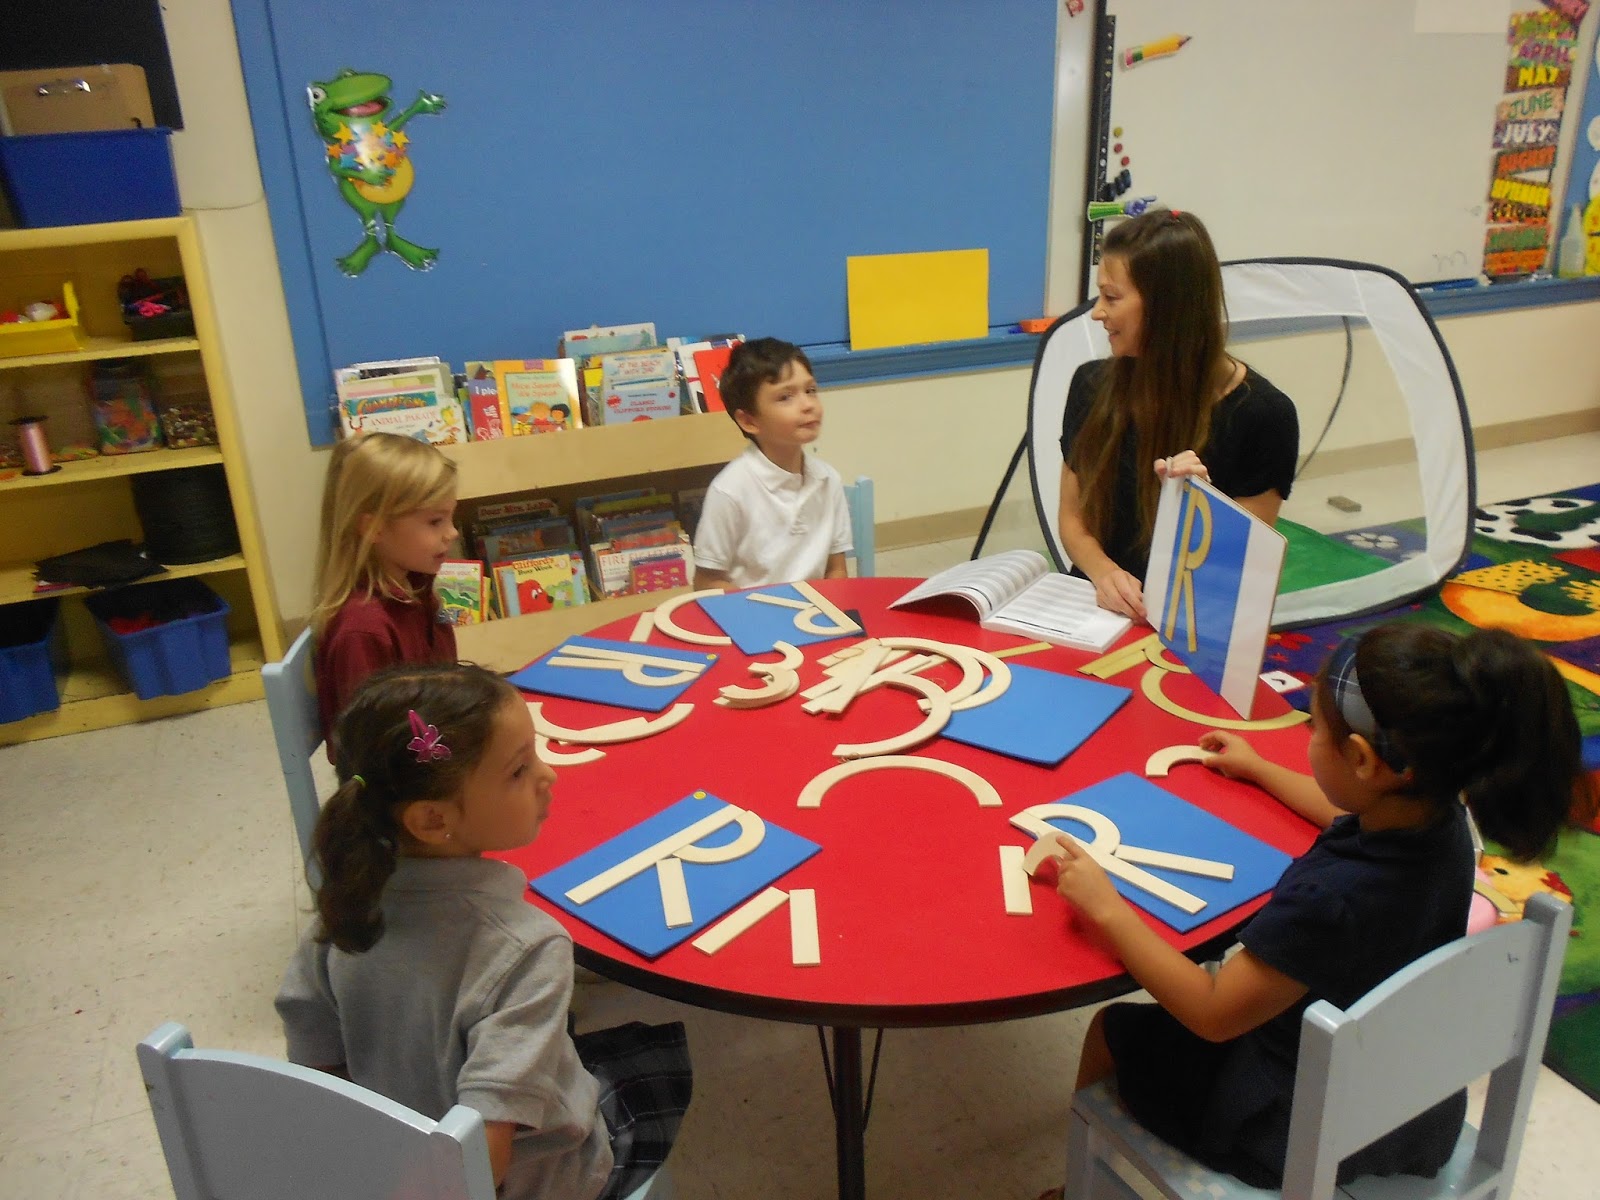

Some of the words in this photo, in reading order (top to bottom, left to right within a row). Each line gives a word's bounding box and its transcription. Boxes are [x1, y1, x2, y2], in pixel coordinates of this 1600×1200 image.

[1518, 65, 1559, 87] MAY
[1508, 91, 1552, 119] JUNE
[1502, 123, 1552, 144] JULY
[601, 551, 627, 567] FIRE
[1164, 487, 1213, 653] R
[564, 803, 766, 930] R
[1009, 803, 1235, 915] R
